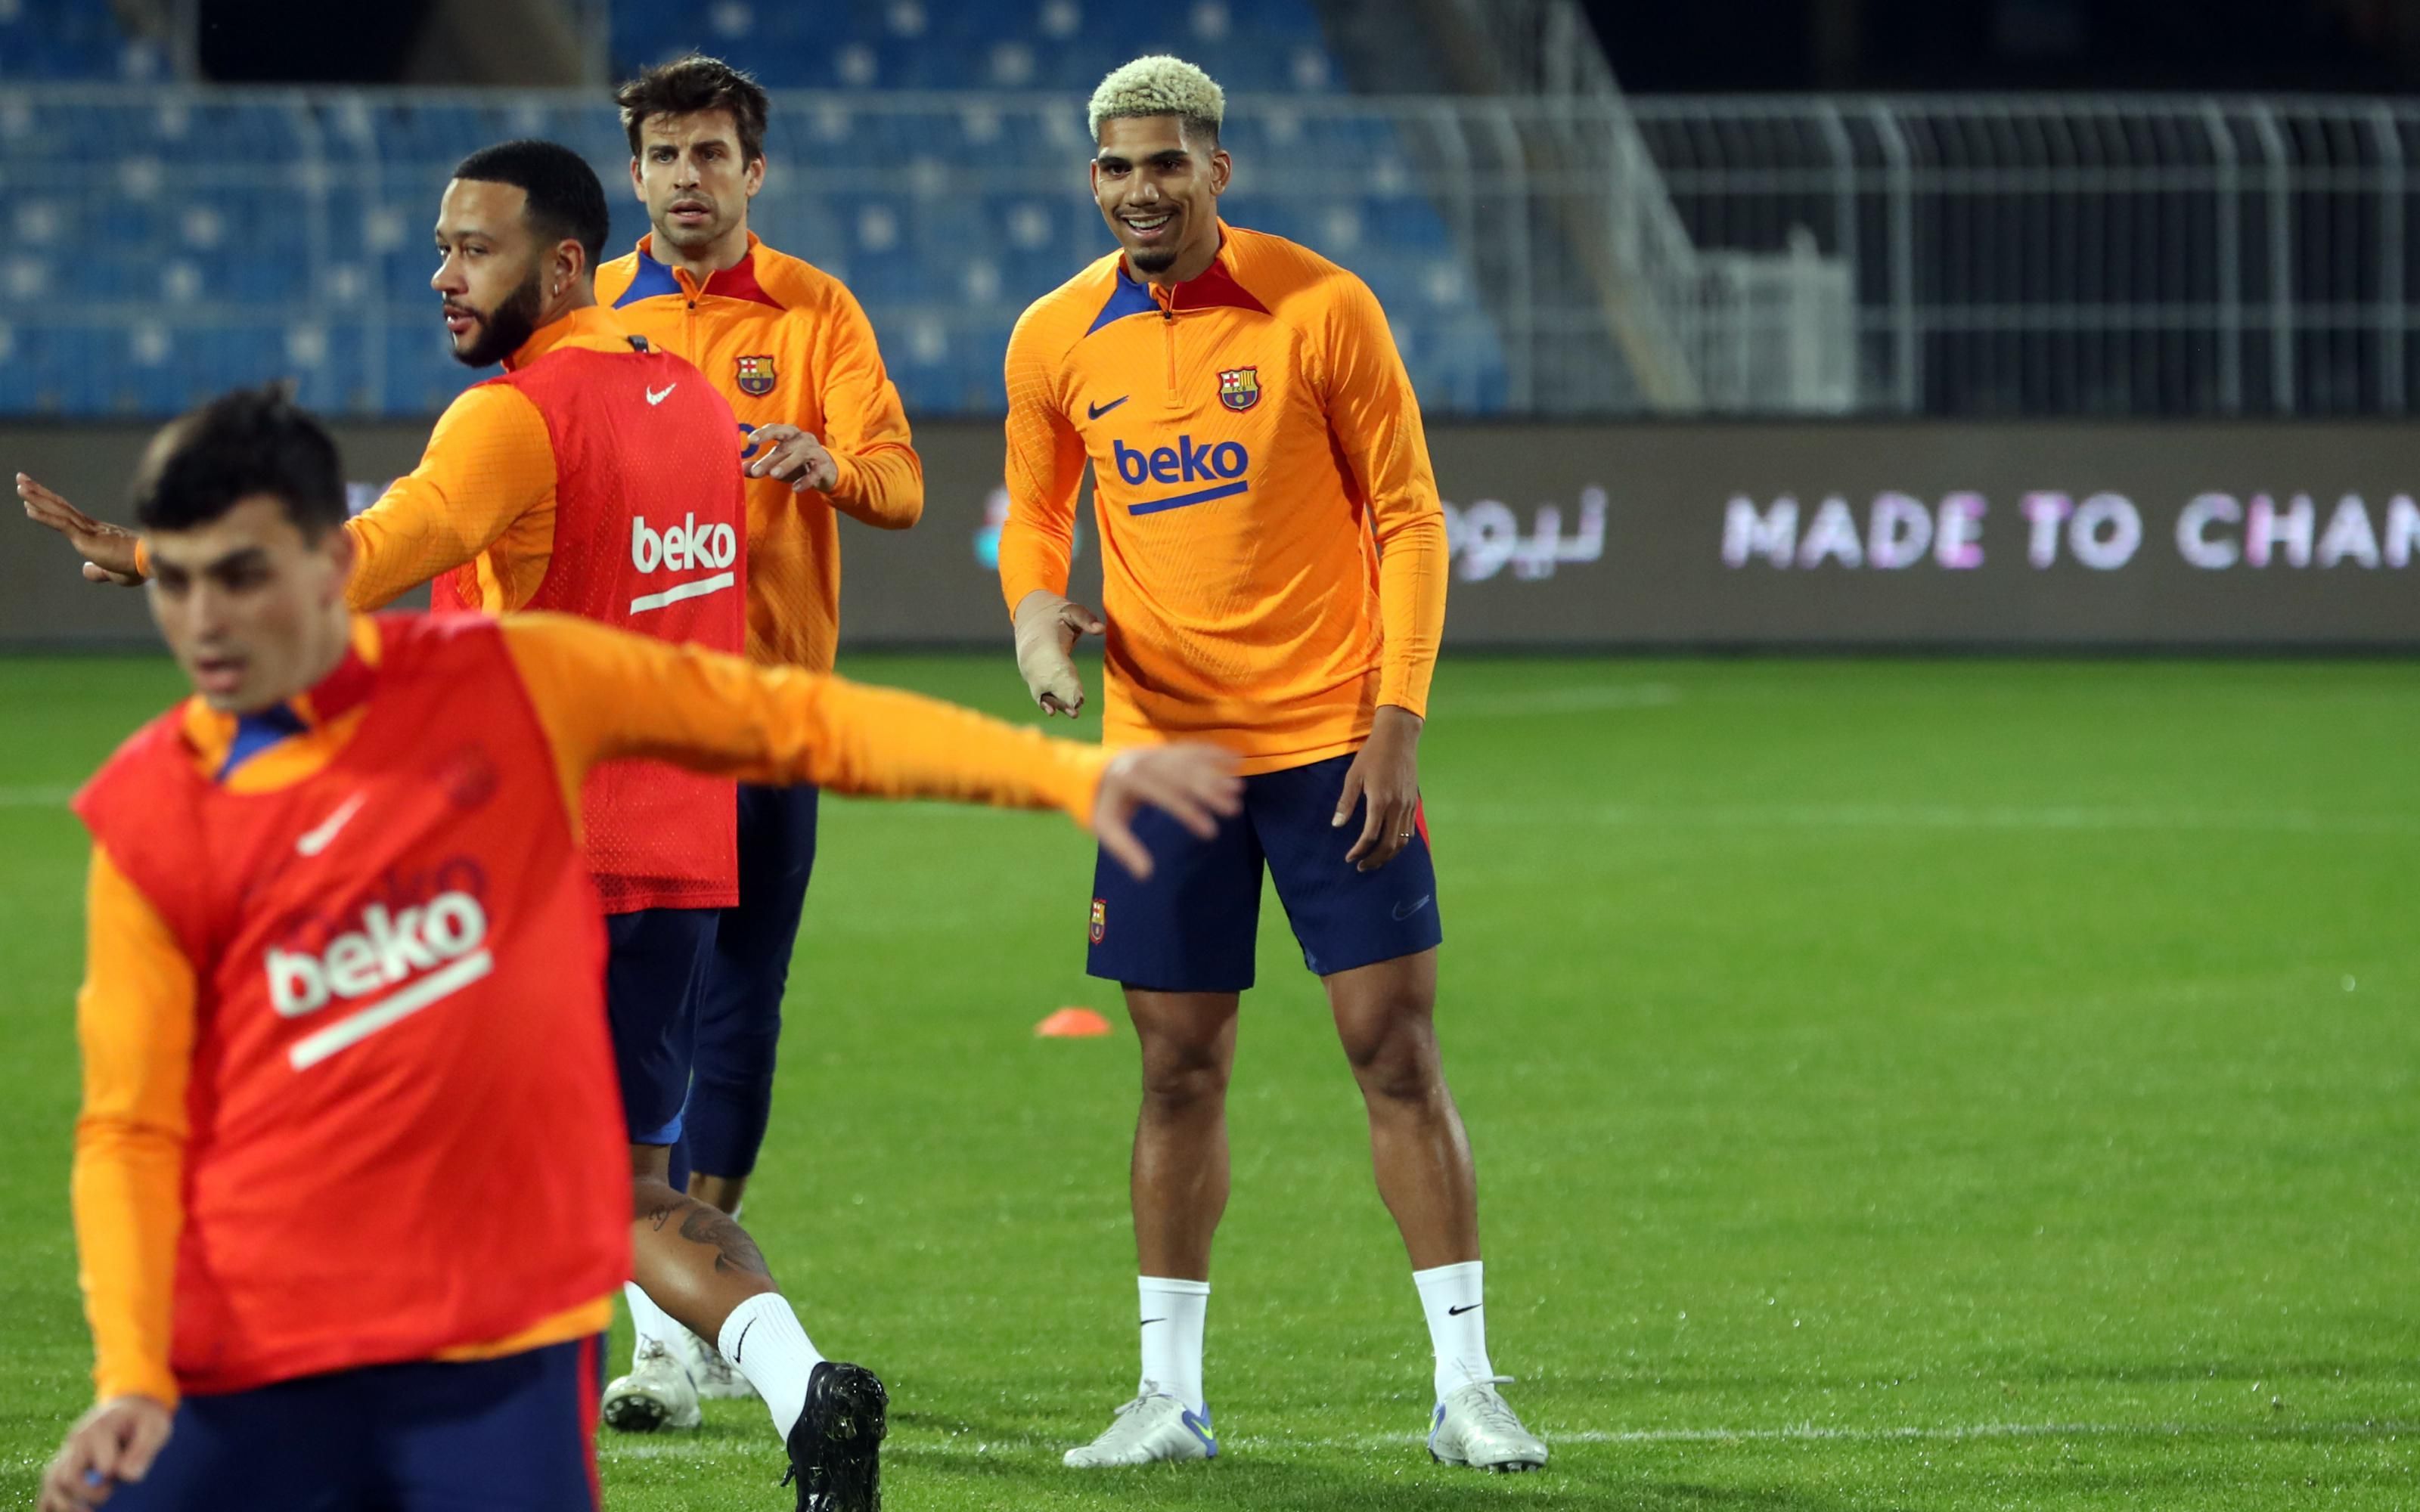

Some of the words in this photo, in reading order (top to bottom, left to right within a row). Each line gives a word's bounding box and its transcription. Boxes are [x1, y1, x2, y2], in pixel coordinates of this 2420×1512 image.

[1113, 435, 1249, 486] beko
[631, 512, 737, 574] beko
[1722, 492, 1987, 569] MADE
[2021, 492, 2142, 569] TO
[265, 891, 486, 1018] beko
